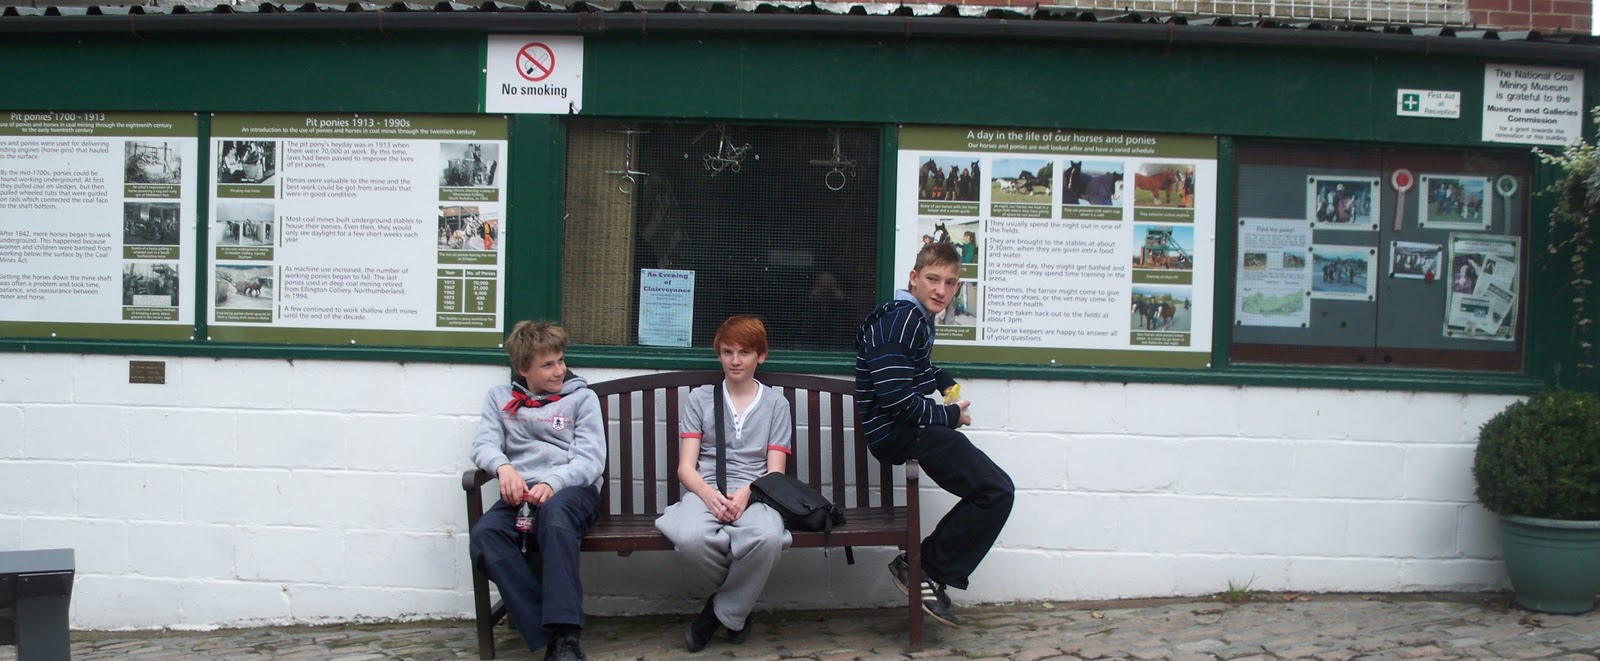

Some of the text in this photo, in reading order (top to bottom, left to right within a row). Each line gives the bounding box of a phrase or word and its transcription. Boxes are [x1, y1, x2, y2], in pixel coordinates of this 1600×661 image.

[1495, 69, 1574, 81] The National Coal
[1500, 80, 1568, 91] Mining Museum
[502, 84, 567, 98] No smoking
[1507, 93, 1540, 101] grateful
[1557, 95, 1570, 103] the
[23, 113, 51, 122] ponies
[1508, 115, 1557, 124] Commission
[320, 118, 349, 128] ponies
[967, 131, 974, 139] A
[976, 131, 993, 142] day
[996, 132, 1004, 140] in
[1008, 132, 1023, 140] the
[1025, 133, 1040, 141] life
[1042, 133, 1052, 141] of
[1073, 134, 1102, 142] horses
[1105, 135, 1122, 143] and
[1126, 135, 1155, 146] ponies
